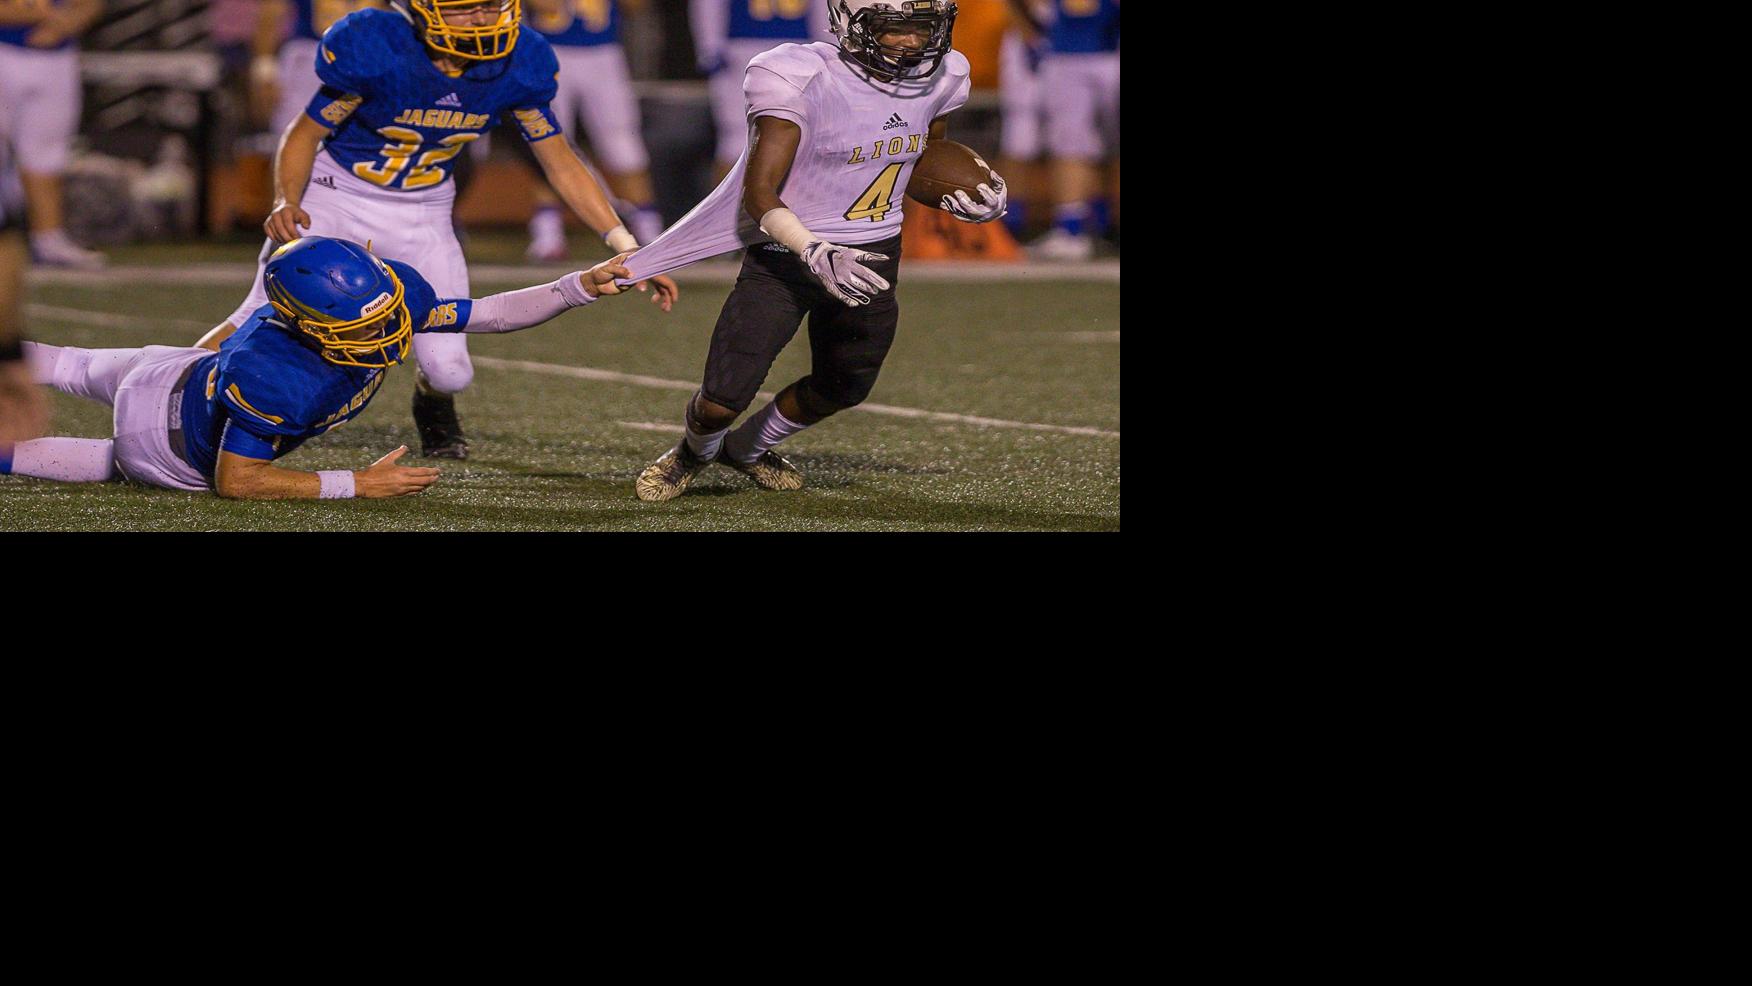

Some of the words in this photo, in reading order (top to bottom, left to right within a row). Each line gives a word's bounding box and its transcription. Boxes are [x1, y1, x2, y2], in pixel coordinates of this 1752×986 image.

[394, 109, 490, 129] JAGUARS
[883, 121, 909, 131] adidas
[352, 126, 480, 191] 32
[842, 161, 906, 222] 4
[364, 294, 389, 314] Riddell
